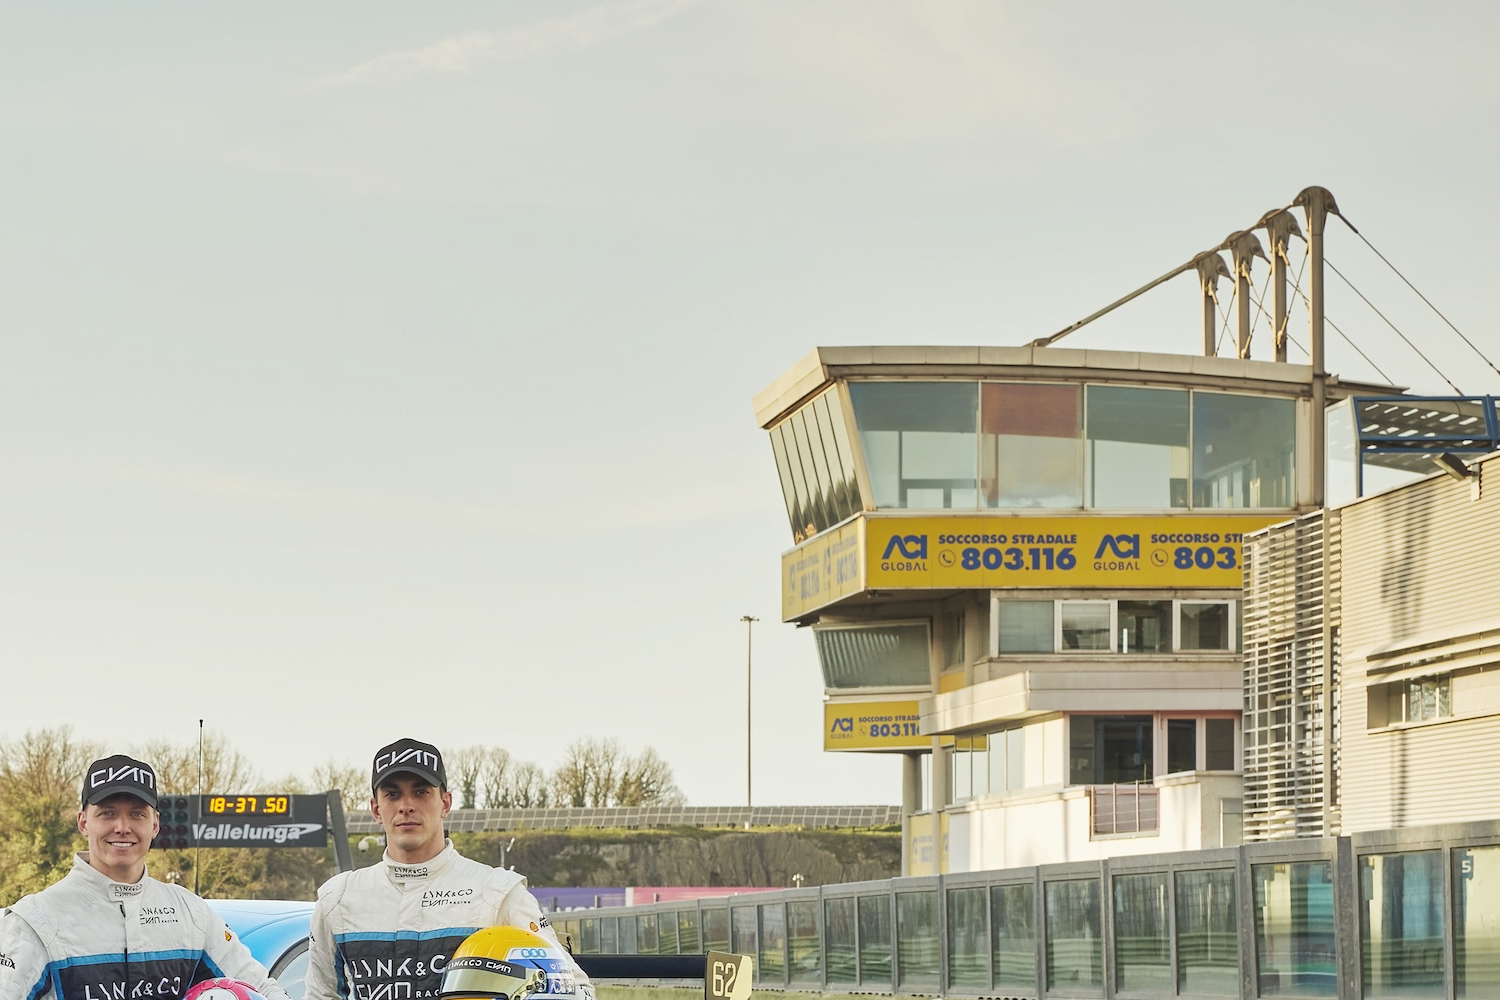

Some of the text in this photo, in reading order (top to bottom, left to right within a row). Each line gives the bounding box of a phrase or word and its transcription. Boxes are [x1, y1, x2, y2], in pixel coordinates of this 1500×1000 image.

[938, 533, 1077, 545] SOCCORSO STRADALE
[1093, 533, 1140, 560] ACI
[1150, 532, 1220, 544] SOCCORSO
[881, 534, 928, 560] ACI
[881, 561, 928, 572] GLOBAL
[961, 547, 1077, 571] 803.116
[1093, 560, 1141, 571] GLOBAL
[1173, 546, 1243, 570] 803.
[858, 715, 893, 723] SOCCORSO
[192, 823, 302, 844] Vallelunga
[1461, 860, 1472, 873] 5
[352, 954, 446, 979] LYNK&C
[713, 961, 737, 998] 62
[416, 988, 441, 999] RAC
